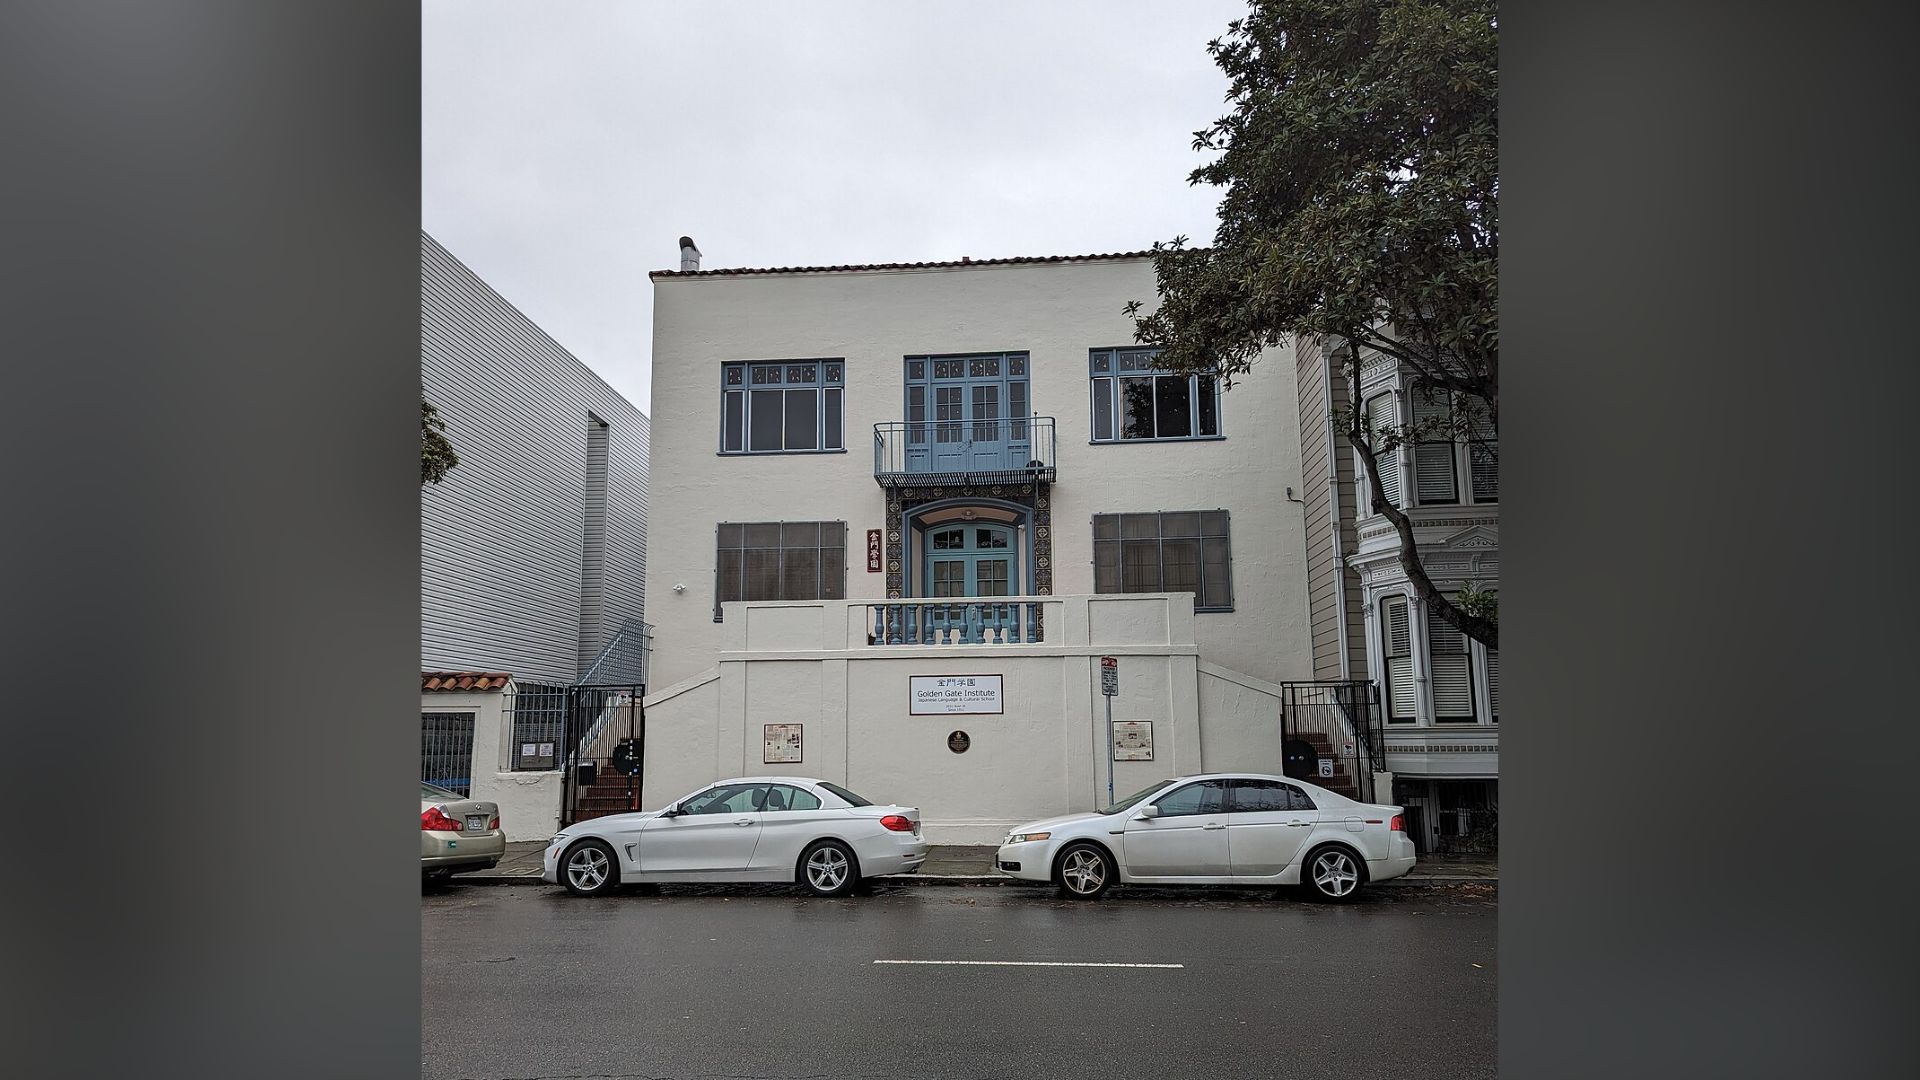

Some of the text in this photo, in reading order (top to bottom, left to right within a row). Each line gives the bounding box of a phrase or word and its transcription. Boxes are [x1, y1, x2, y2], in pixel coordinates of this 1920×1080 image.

[917, 689, 996, 698] Golden Gate Institute
